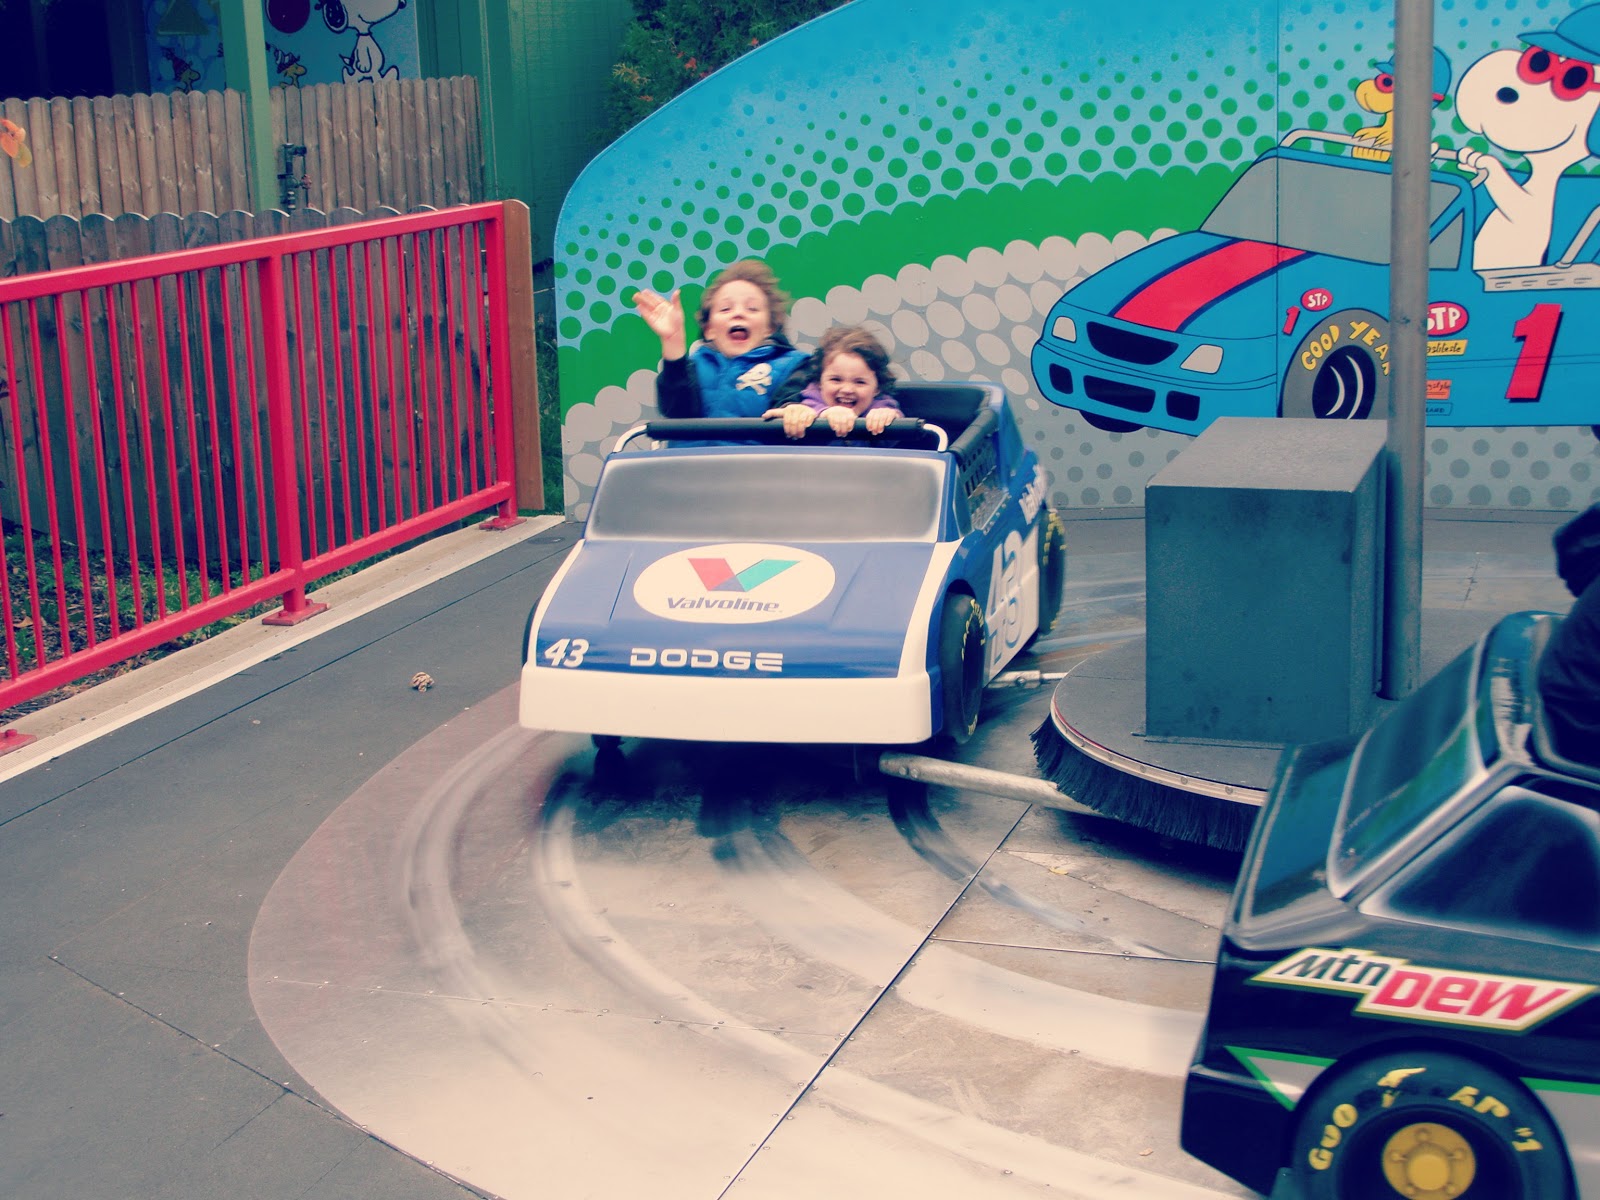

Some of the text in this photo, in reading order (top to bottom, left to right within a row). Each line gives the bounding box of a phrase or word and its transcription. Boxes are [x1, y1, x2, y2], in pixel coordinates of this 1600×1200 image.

[1307, 292, 1329, 309] STP
[1282, 306, 1300, 336] 1
[1301, 325, 1341, 371] GOOD
[1505, 303, 1563, 402] 1
[667, 597, 779, 613] Valvoline
[544, 637, 590, 667] 43
[629, 647, 784, 672] DODGE
[1274, 954, 1392, 987] Mtn
